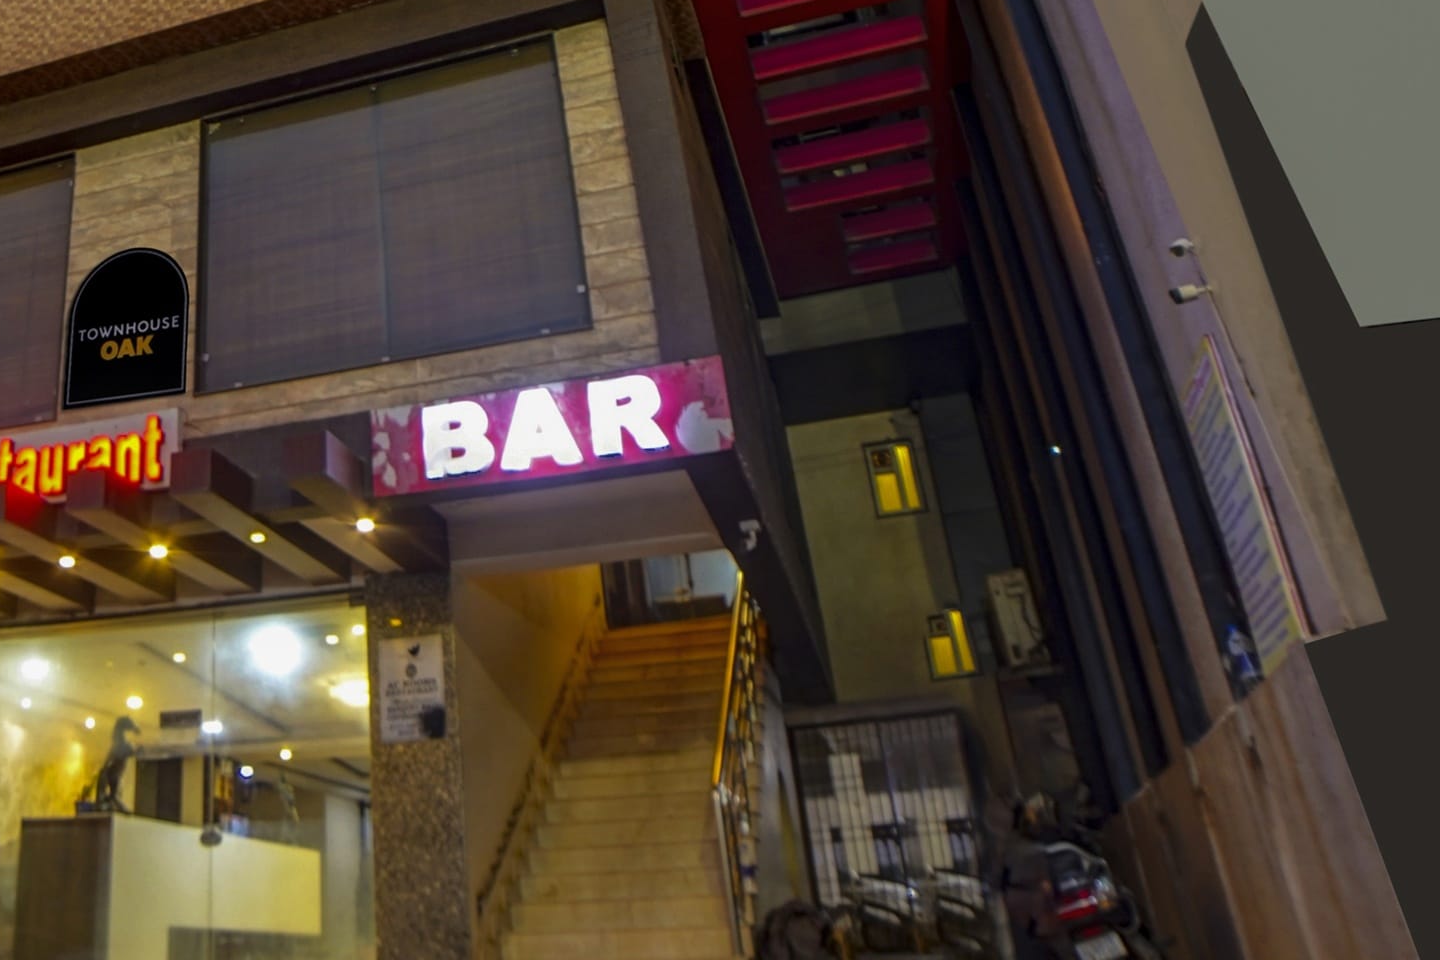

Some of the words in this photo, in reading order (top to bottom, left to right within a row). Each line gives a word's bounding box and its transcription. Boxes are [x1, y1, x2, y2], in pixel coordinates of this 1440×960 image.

[78, 315, 180, 342] TOWNHOUSE
[100, 334, 154, 361] OAK
[422, 375, 670, 480] BAR
